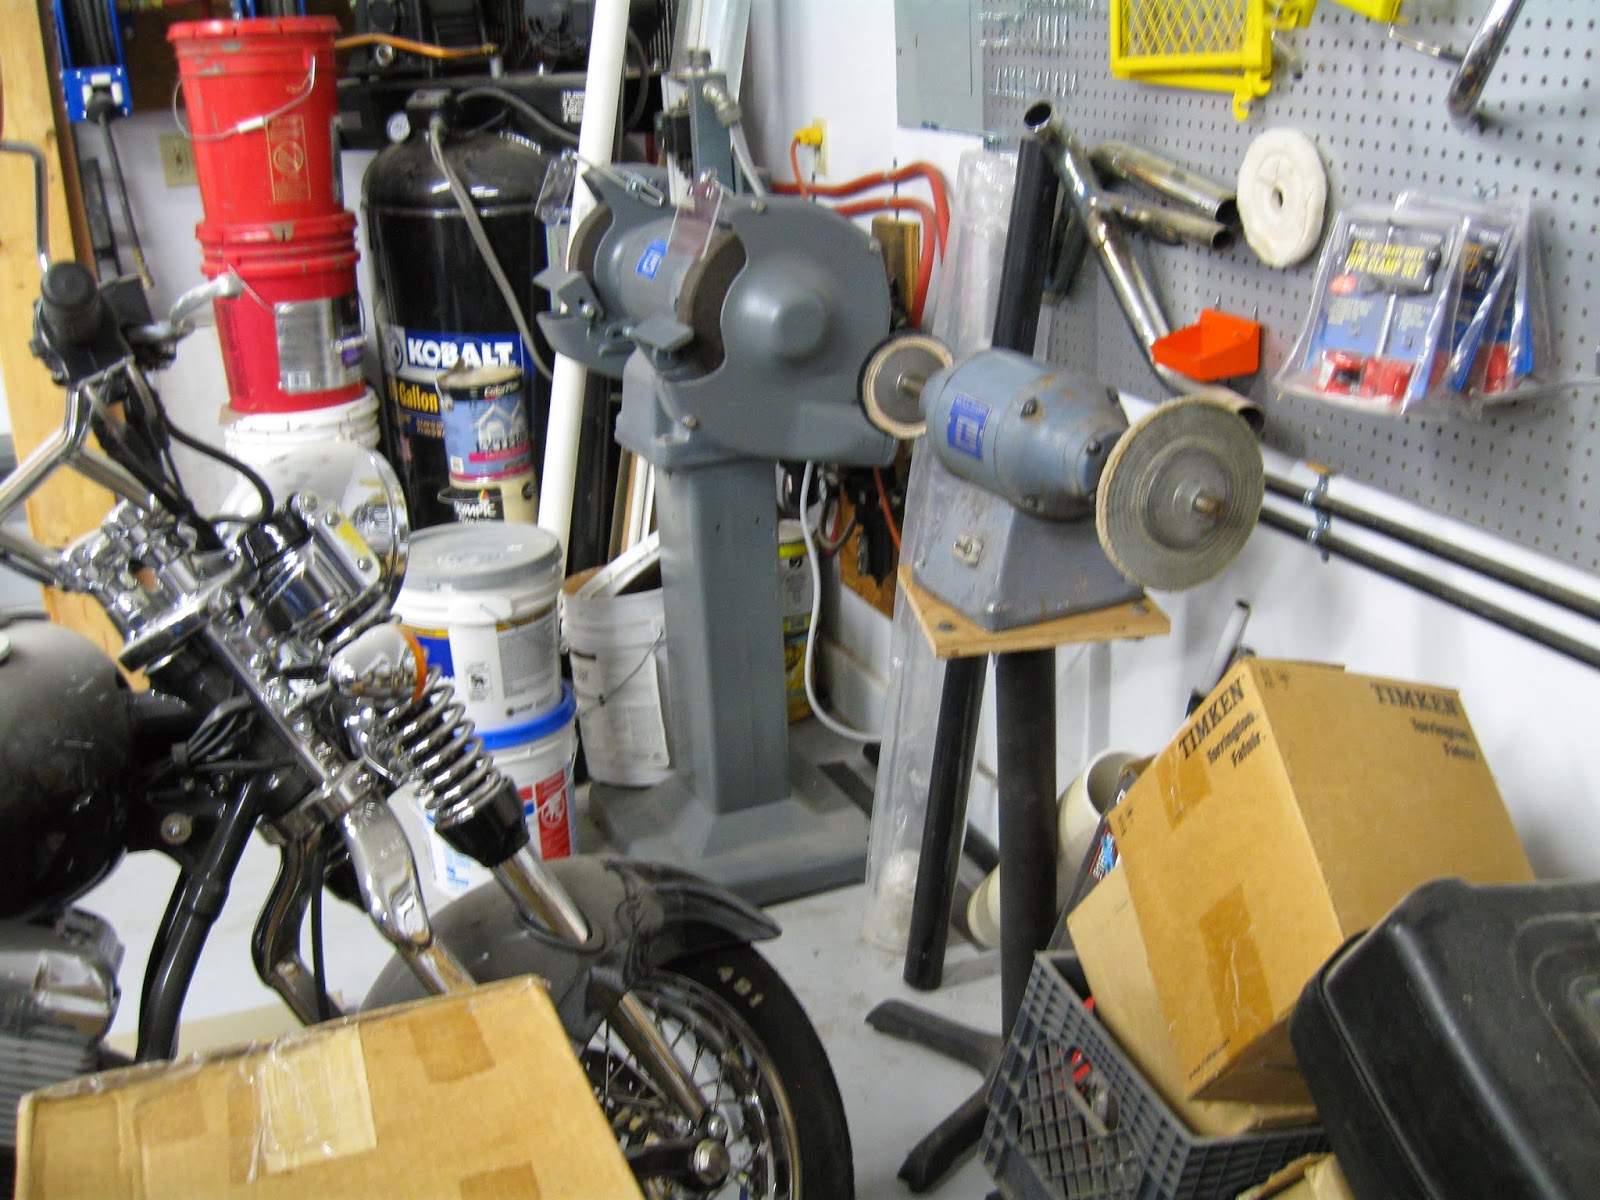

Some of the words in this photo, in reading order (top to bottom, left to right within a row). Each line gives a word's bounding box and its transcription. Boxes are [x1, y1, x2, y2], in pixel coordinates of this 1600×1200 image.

[407, 337, 514, 369] KOBALT
[399, 381, 439, 414] Gallon
[1369, 682, 1459, 717] TIMKEN
[1178, 676, 1245, 760] TIMKEN
